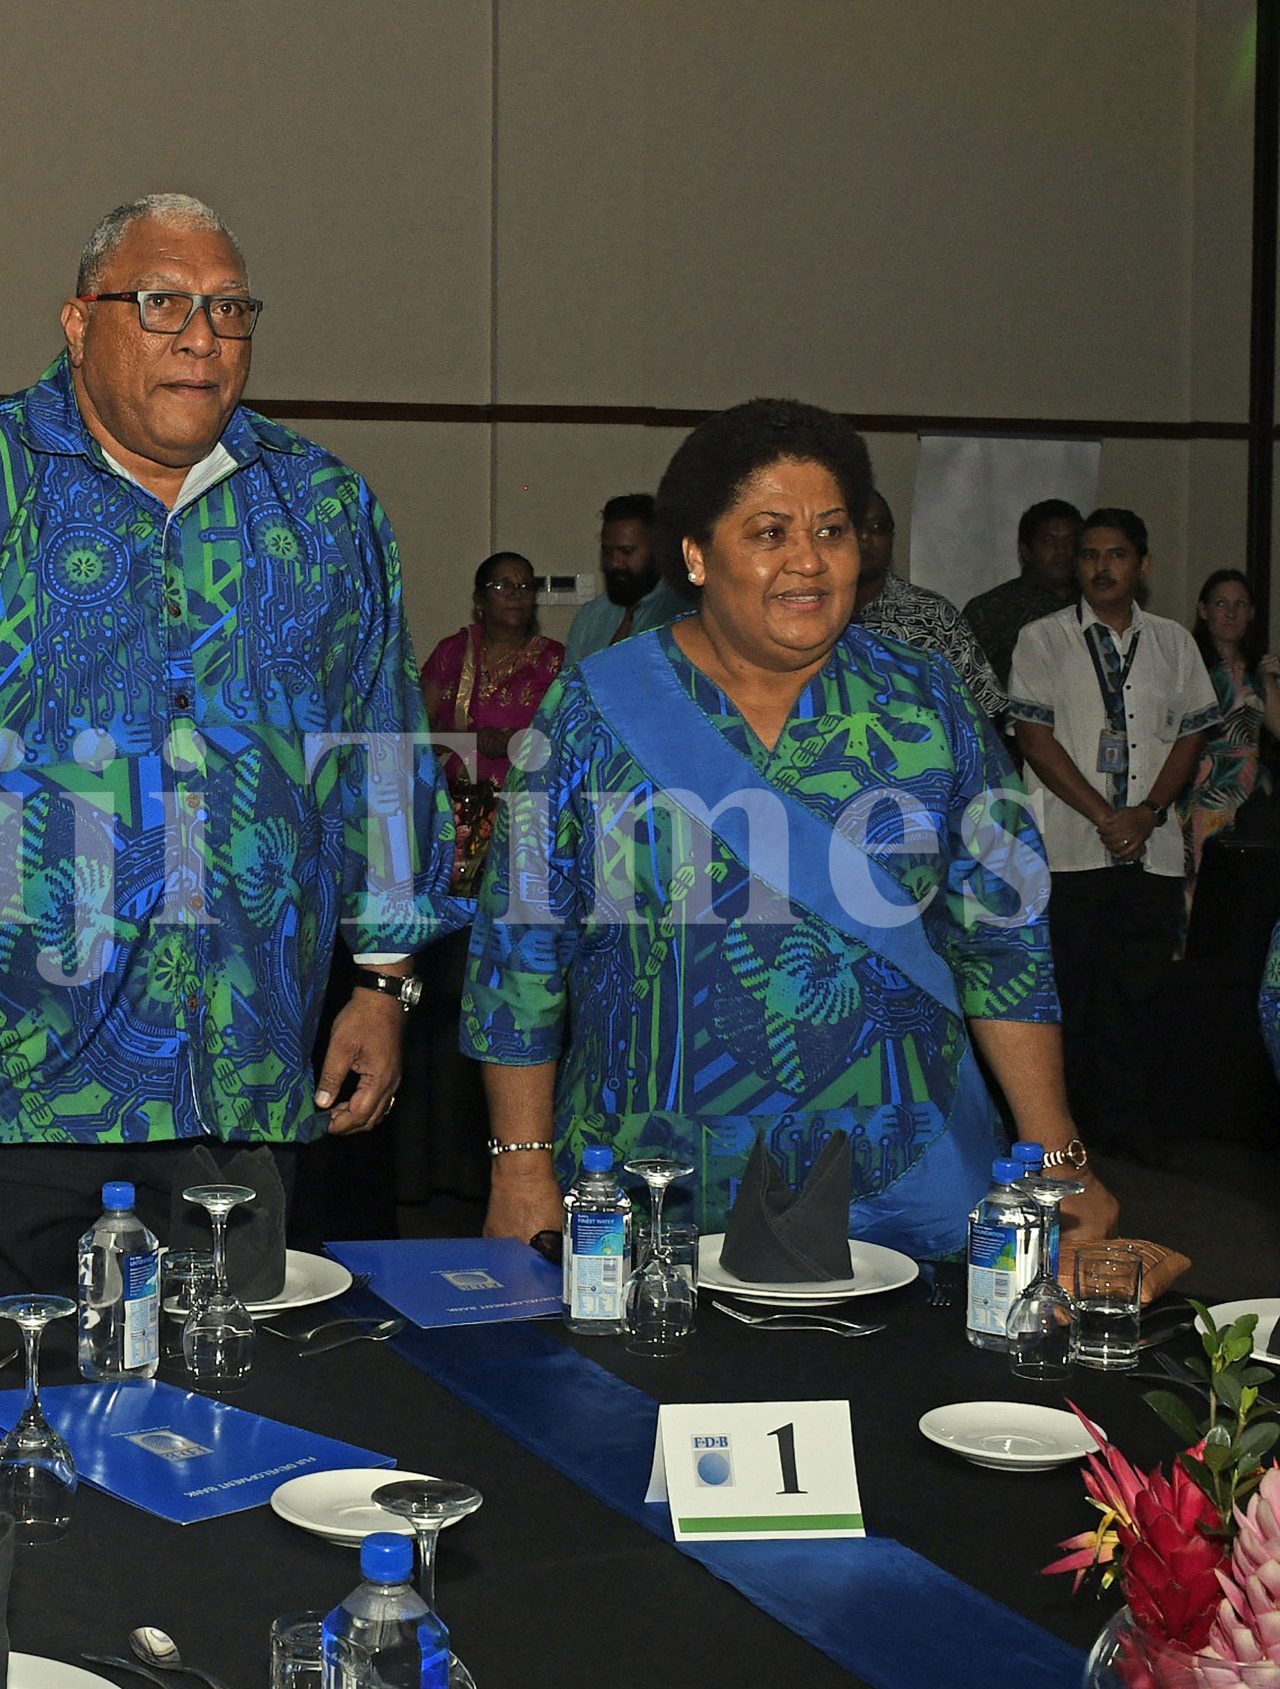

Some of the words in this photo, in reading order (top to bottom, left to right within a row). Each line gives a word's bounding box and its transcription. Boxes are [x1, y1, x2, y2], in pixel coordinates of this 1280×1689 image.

[766, 1422, 809, 1495] 1
[216, 1462, 297, 1490] DEVELOPMENT
[184, 1483, 218, 1498] BANK
